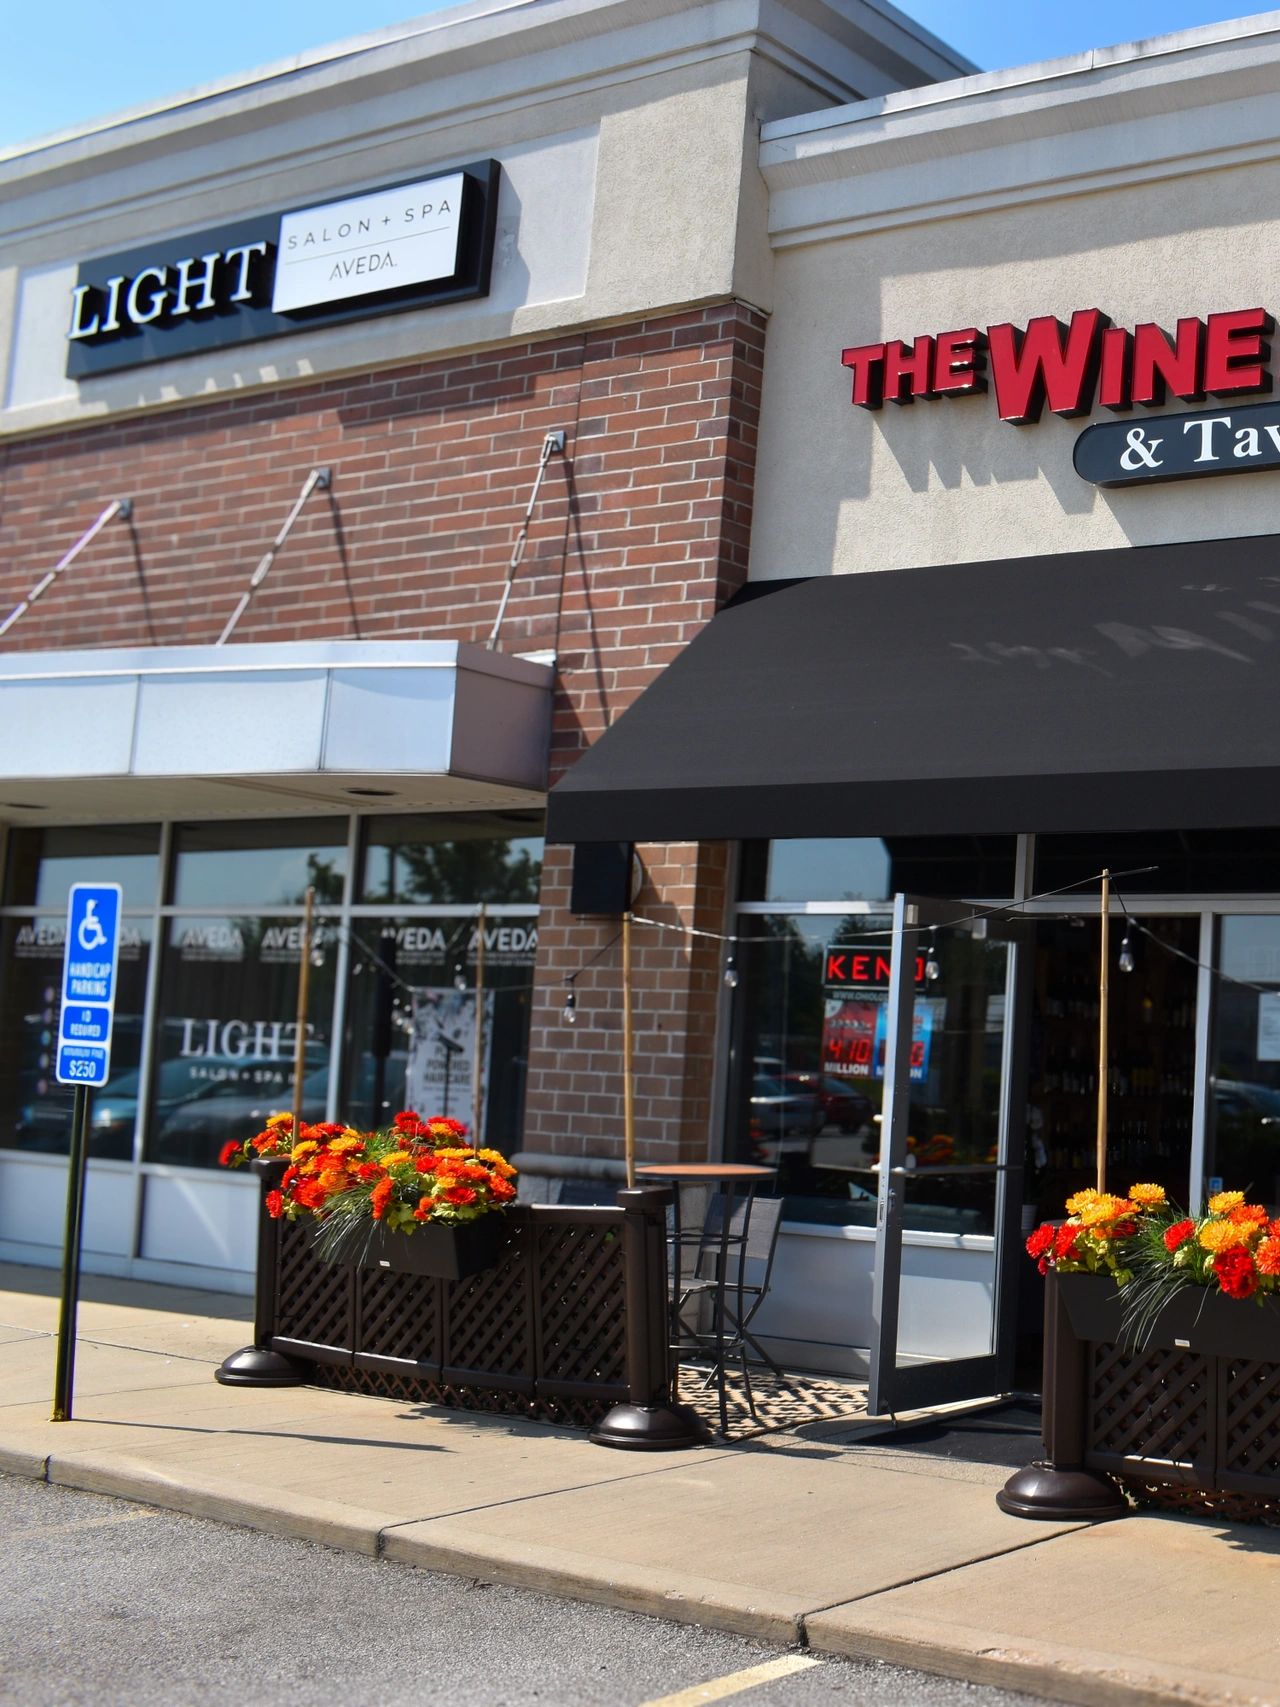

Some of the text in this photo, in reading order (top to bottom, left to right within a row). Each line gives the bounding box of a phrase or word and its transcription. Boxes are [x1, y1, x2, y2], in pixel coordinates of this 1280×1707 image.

[287, 218, 371, 250] SALON
[404, 199, 451, 223] SPA
[68, 241, 271, 341] LIGHT
[841, 329, 989, 411] THE
[988, 307, 1275, 426] WINE
[1119, 427, 1164, 472] &
[182, 926, 244, 949] AVEDA
[69, 962, 112, 979] HANDICAP
[71, 979, 107, 997] PARKING
[180, 1018, 315, 1062] LIGHT
[69, 1060, 97, 1078] $250
[189, 1066, 239, 1081] SALON
[254, 1069, 283, 1084] SPA
[823, 1062, 869, 1076] MILLION
